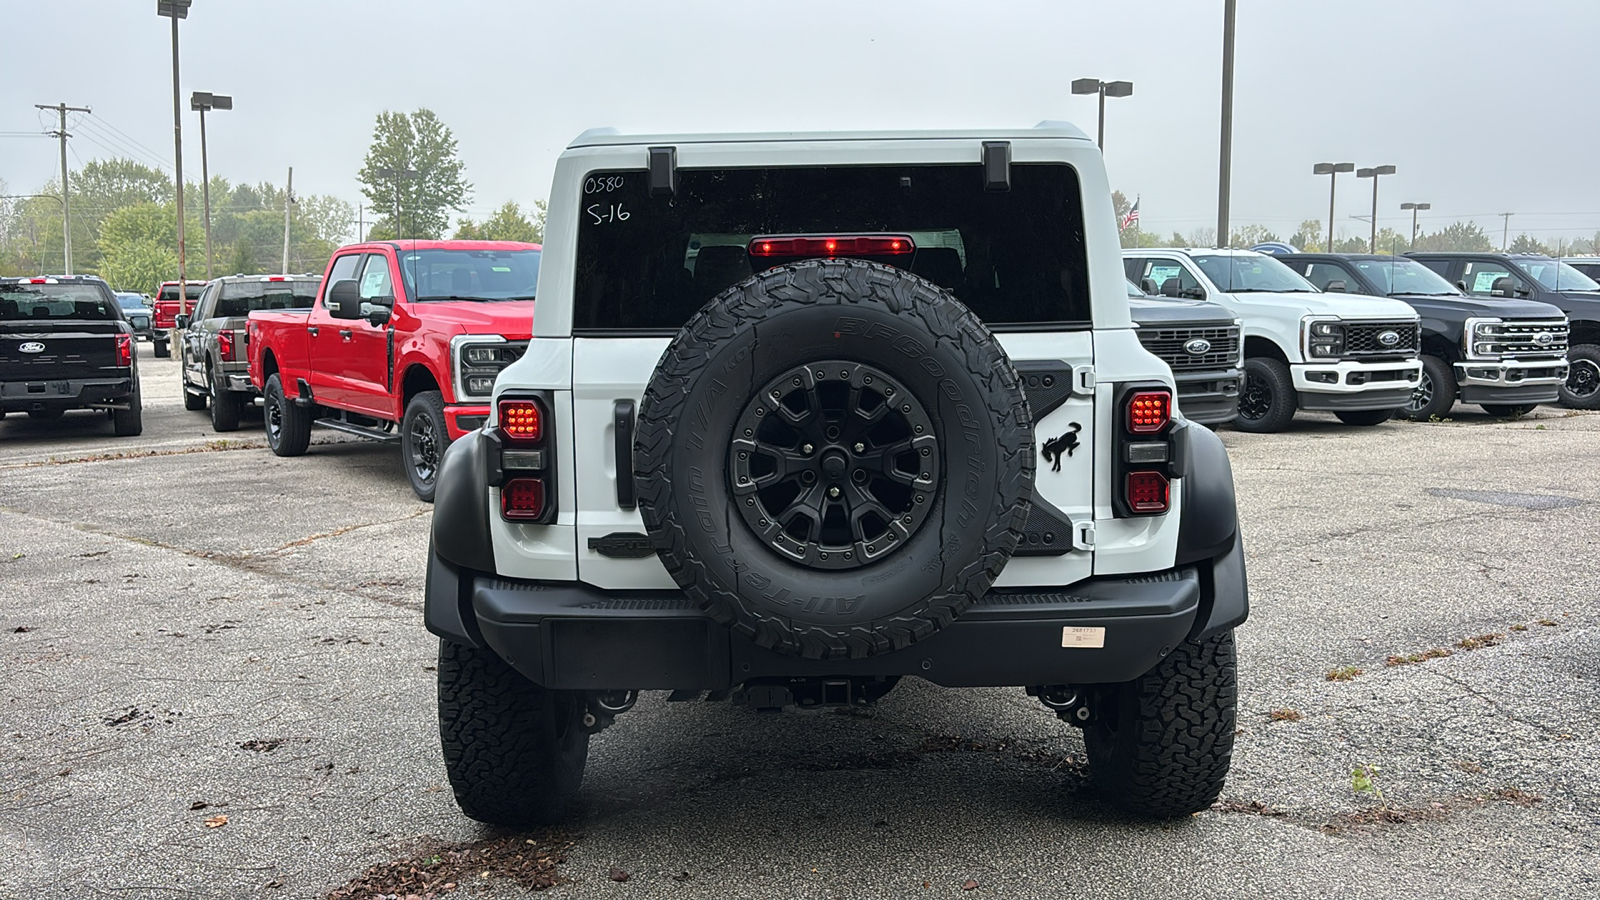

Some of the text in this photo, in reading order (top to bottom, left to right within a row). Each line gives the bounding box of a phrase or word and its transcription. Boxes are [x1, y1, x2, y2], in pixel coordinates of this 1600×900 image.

[584, 176, 624, 194] 0580
[587, 203, 631, 225] S-16
[833, 316, 986, 528] BFGoodrich
